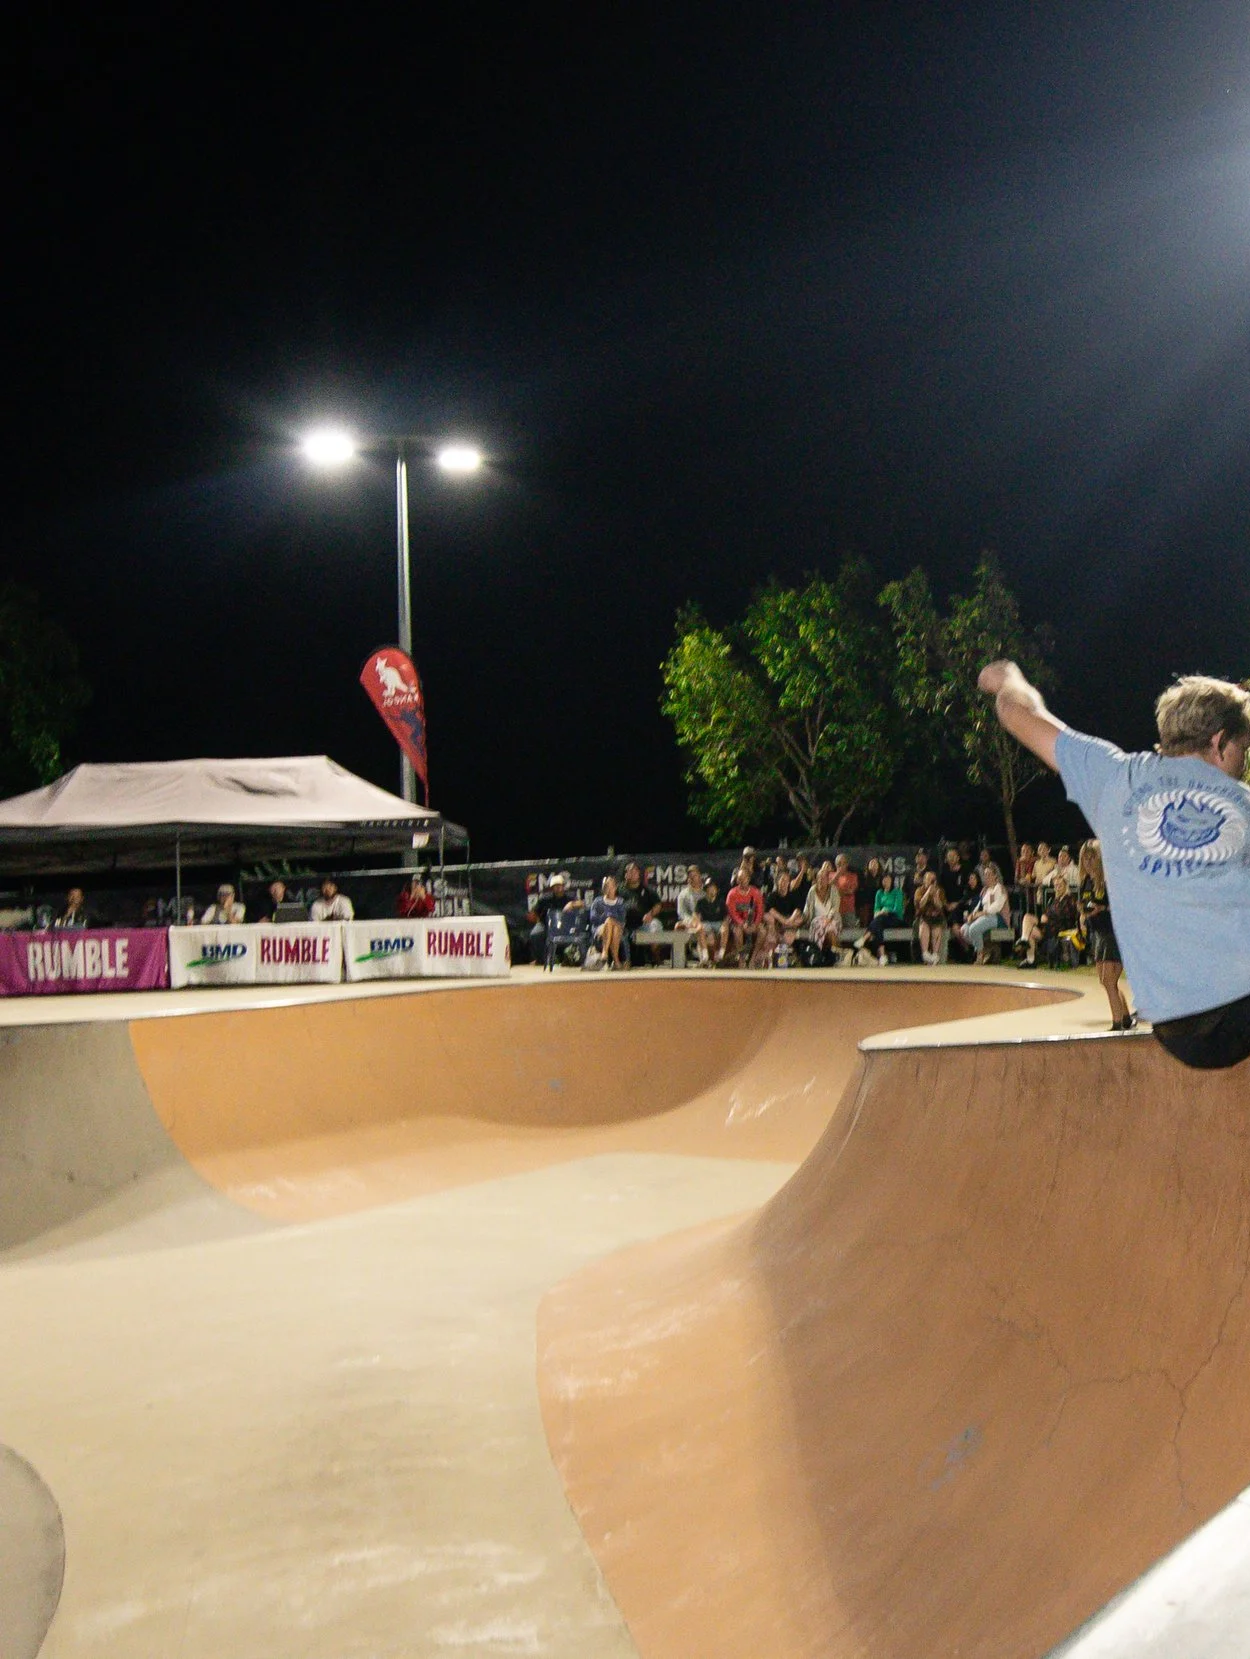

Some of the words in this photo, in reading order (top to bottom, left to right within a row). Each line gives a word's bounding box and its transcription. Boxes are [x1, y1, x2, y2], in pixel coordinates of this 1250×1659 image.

[260, 936, 330, 963] RUMBLE
[369, 936, 415, 953] BMD
[427, 930, 494, 958] RUMBLE
[27, 938, 129, 982] RUMBLE
